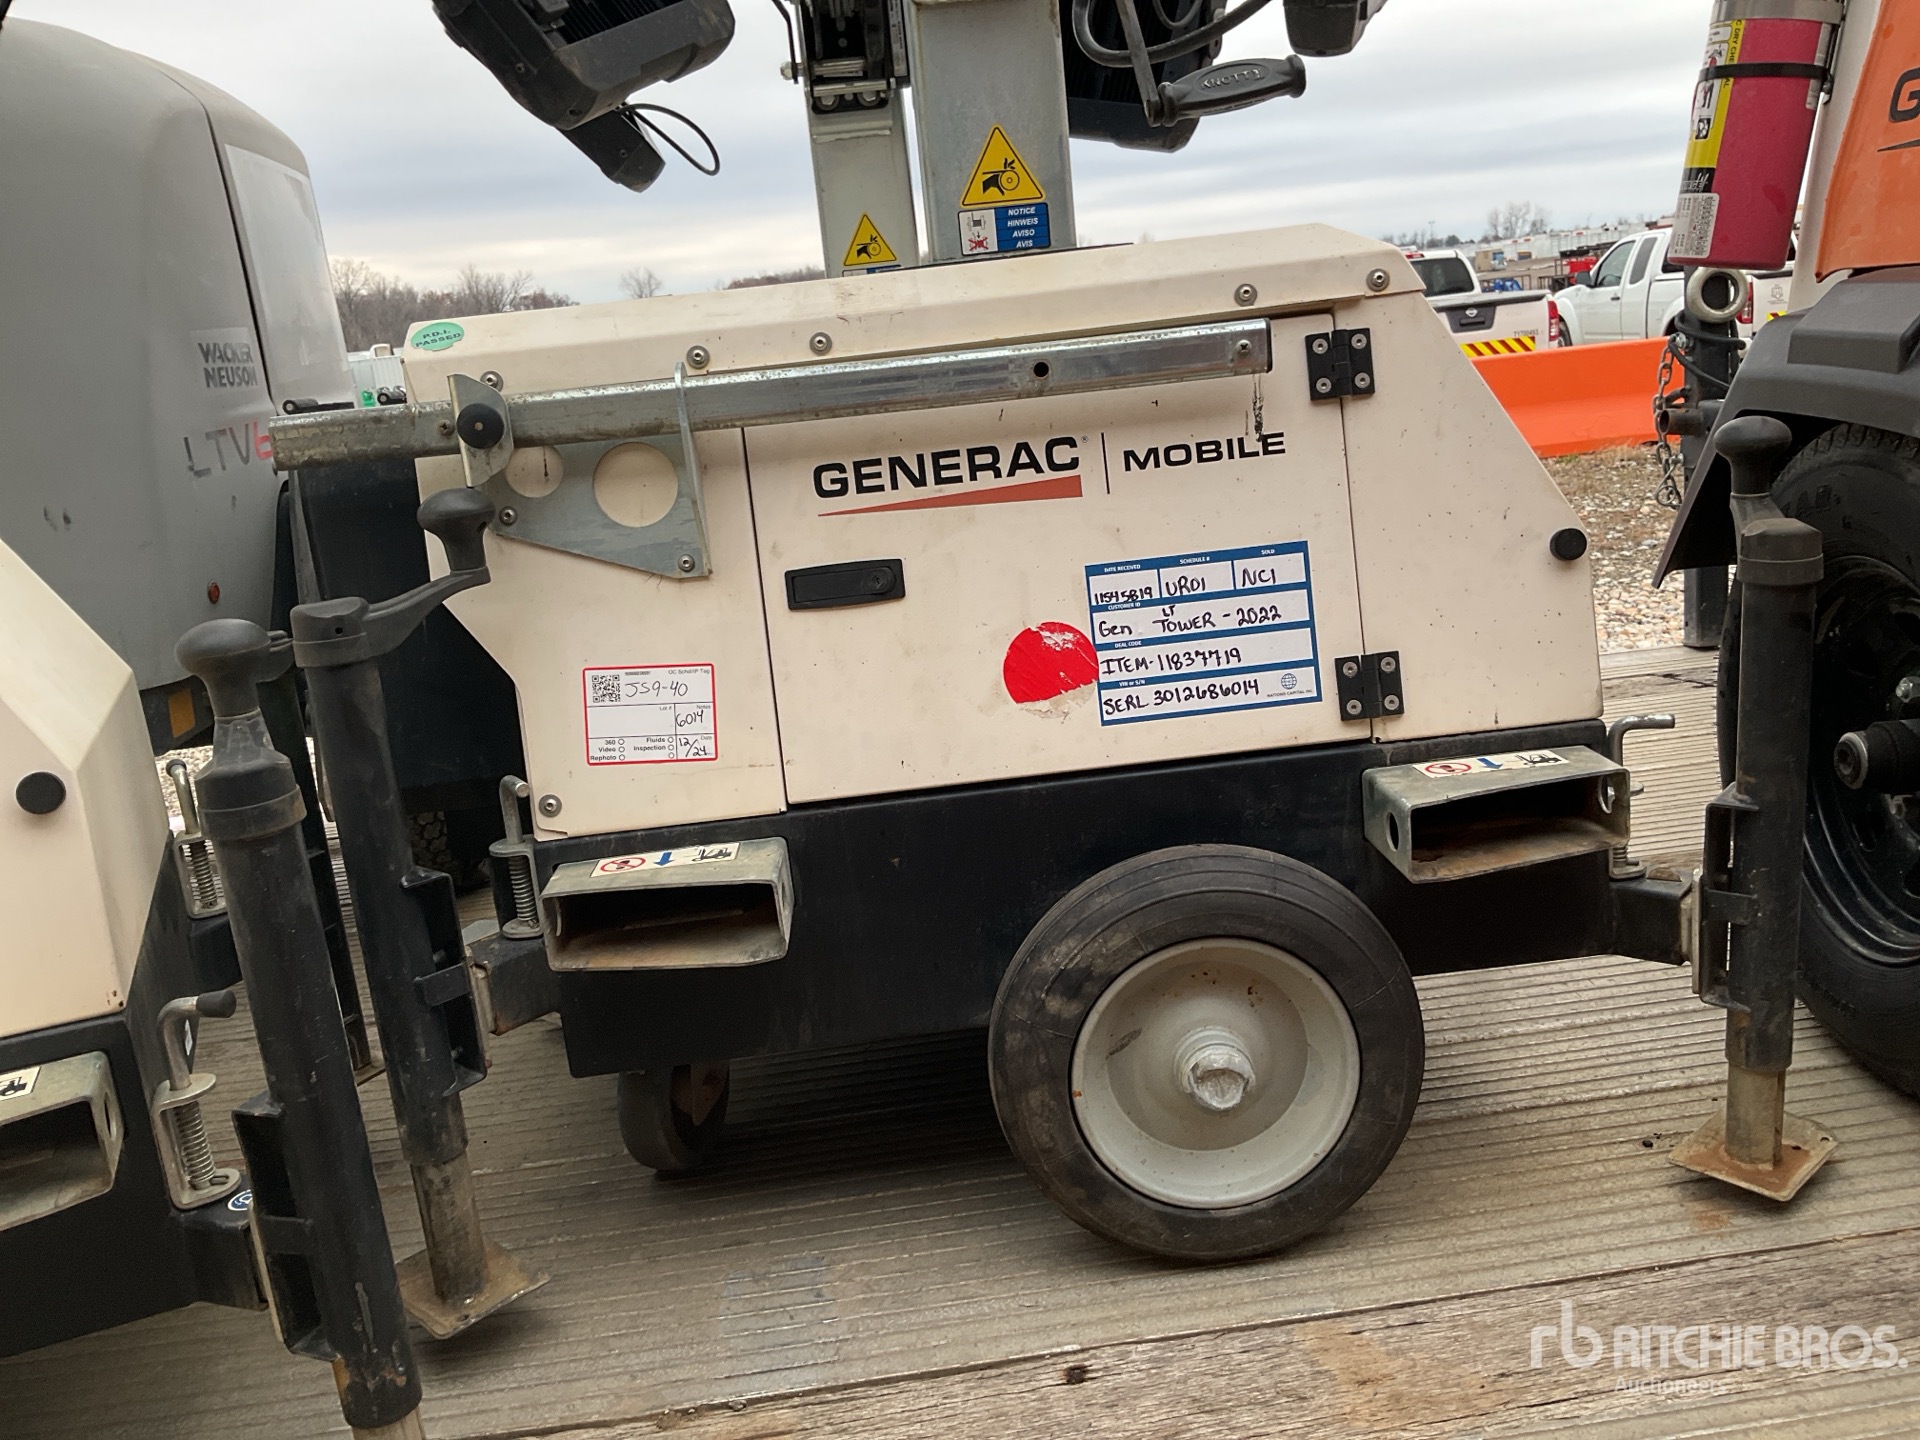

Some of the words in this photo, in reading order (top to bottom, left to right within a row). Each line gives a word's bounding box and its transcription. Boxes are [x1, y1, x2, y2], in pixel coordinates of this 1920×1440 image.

[1008, 206, 1036, 215] NOTICE
[1007, 217, 1039, 227] HINWEIS
[1012, 229, 1035, 237] AVISO
[1016, 240, 1034, 248] AVIS
[415, 332, 461, 347] PASSED
[812, 436, 1080, 498] GENERAC
[1122, 431, 1287, 472] MOBILE
[1098, 620, 1133, 637] Gen
[1152, 611, 1216, 633] TOWER
[1236, 605, 1282, 627] 2022
[1103, 694, 1149, 716] SERL
[676, 710, 704, 727] 6014
